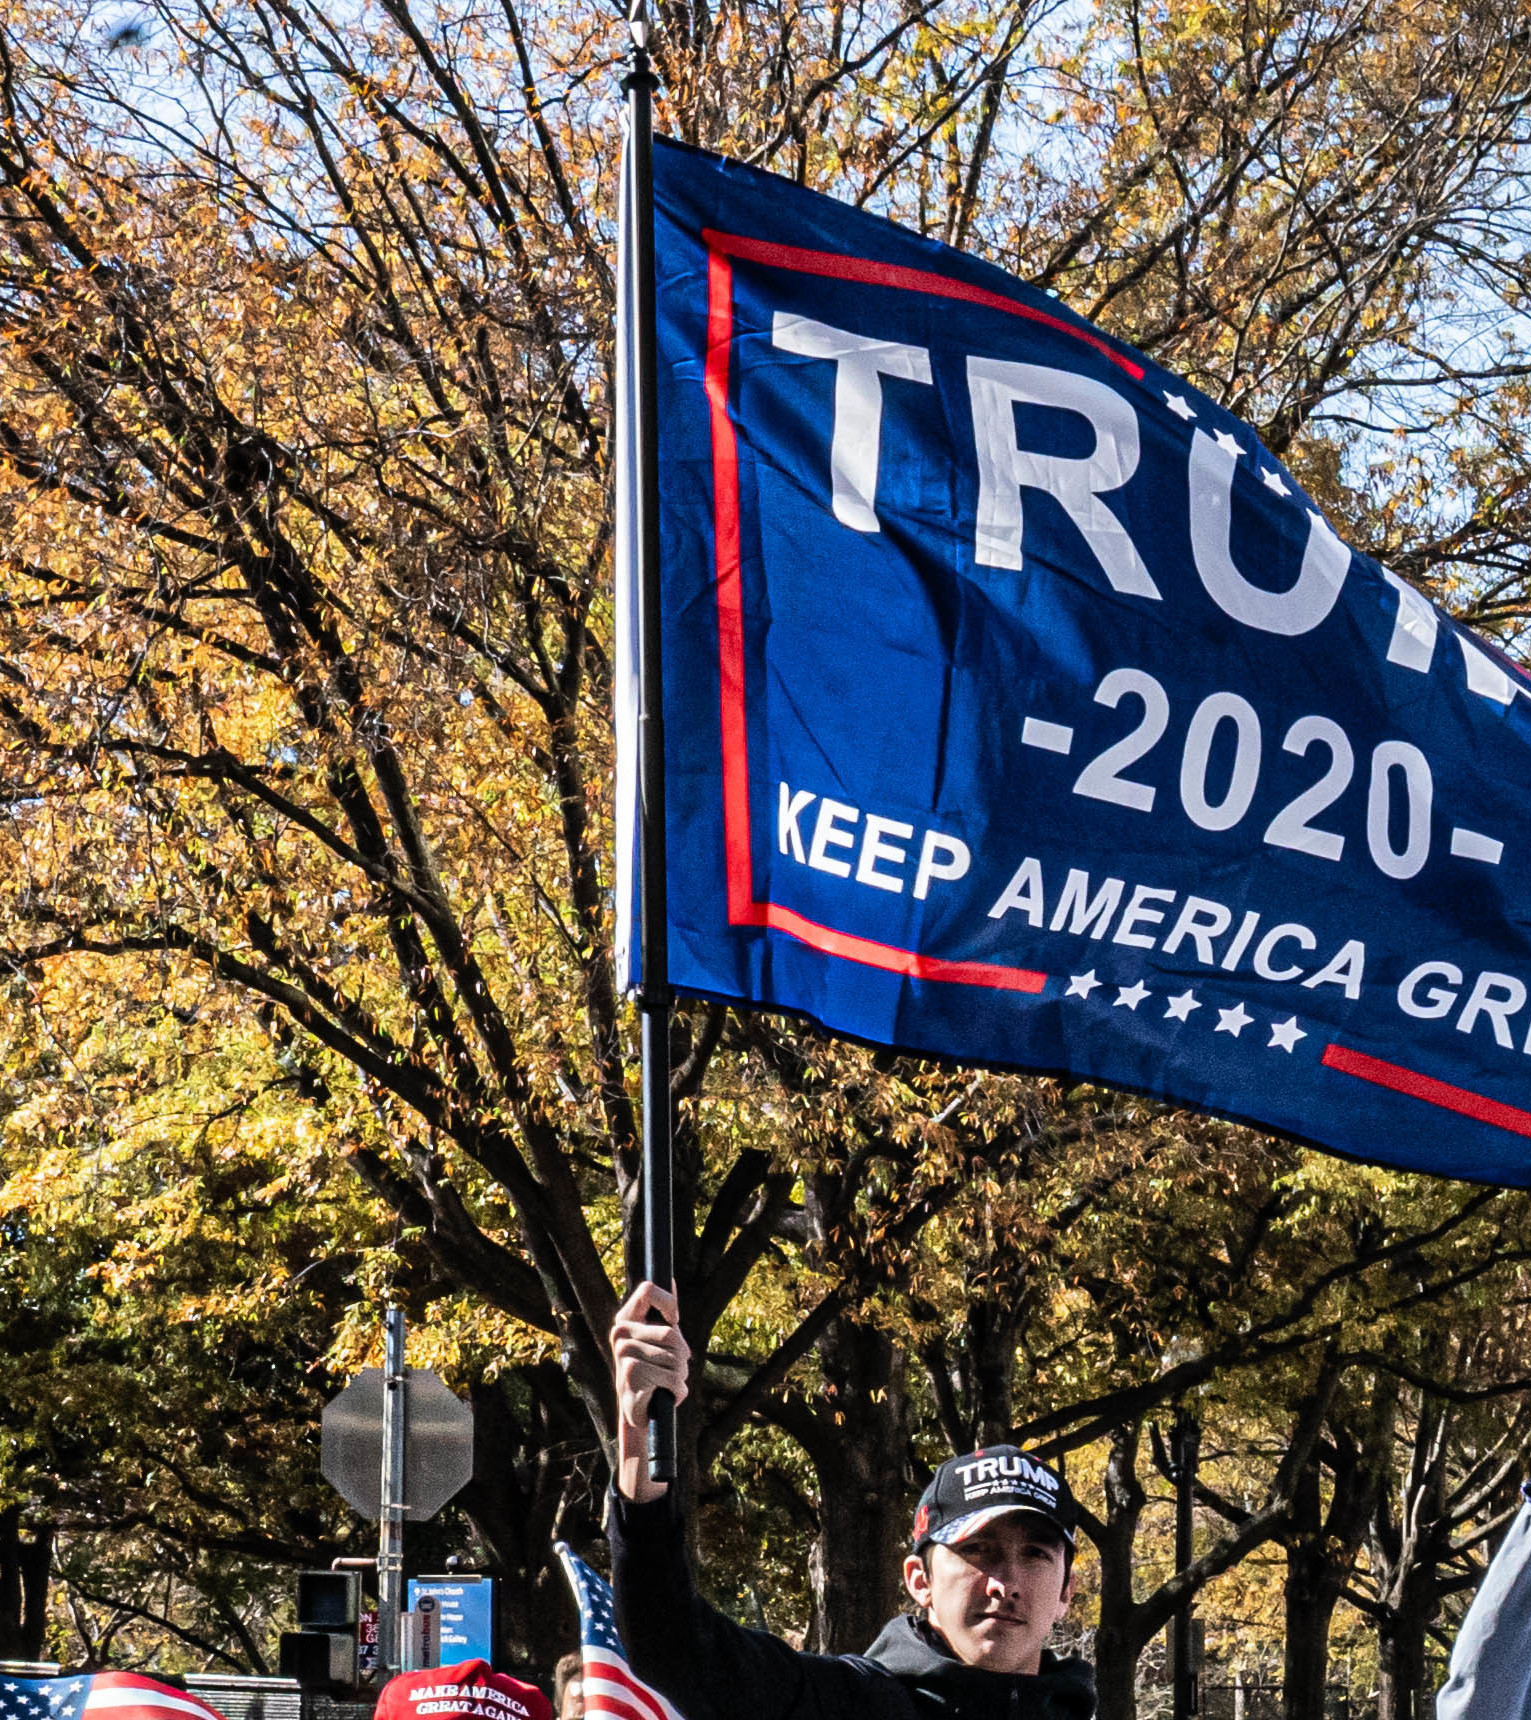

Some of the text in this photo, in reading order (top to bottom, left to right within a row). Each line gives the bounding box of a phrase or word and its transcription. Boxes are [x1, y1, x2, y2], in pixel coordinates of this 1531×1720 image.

[778, 781, 971, 901] KEEP
[988, 856, 1367, 1001] AMERICA
[955, 1456, 1060, 1491] TRUMP
[408, 1684, 530, 1717] MAKE AMERICA
[416, 1700, 473, 1715] GREAT
